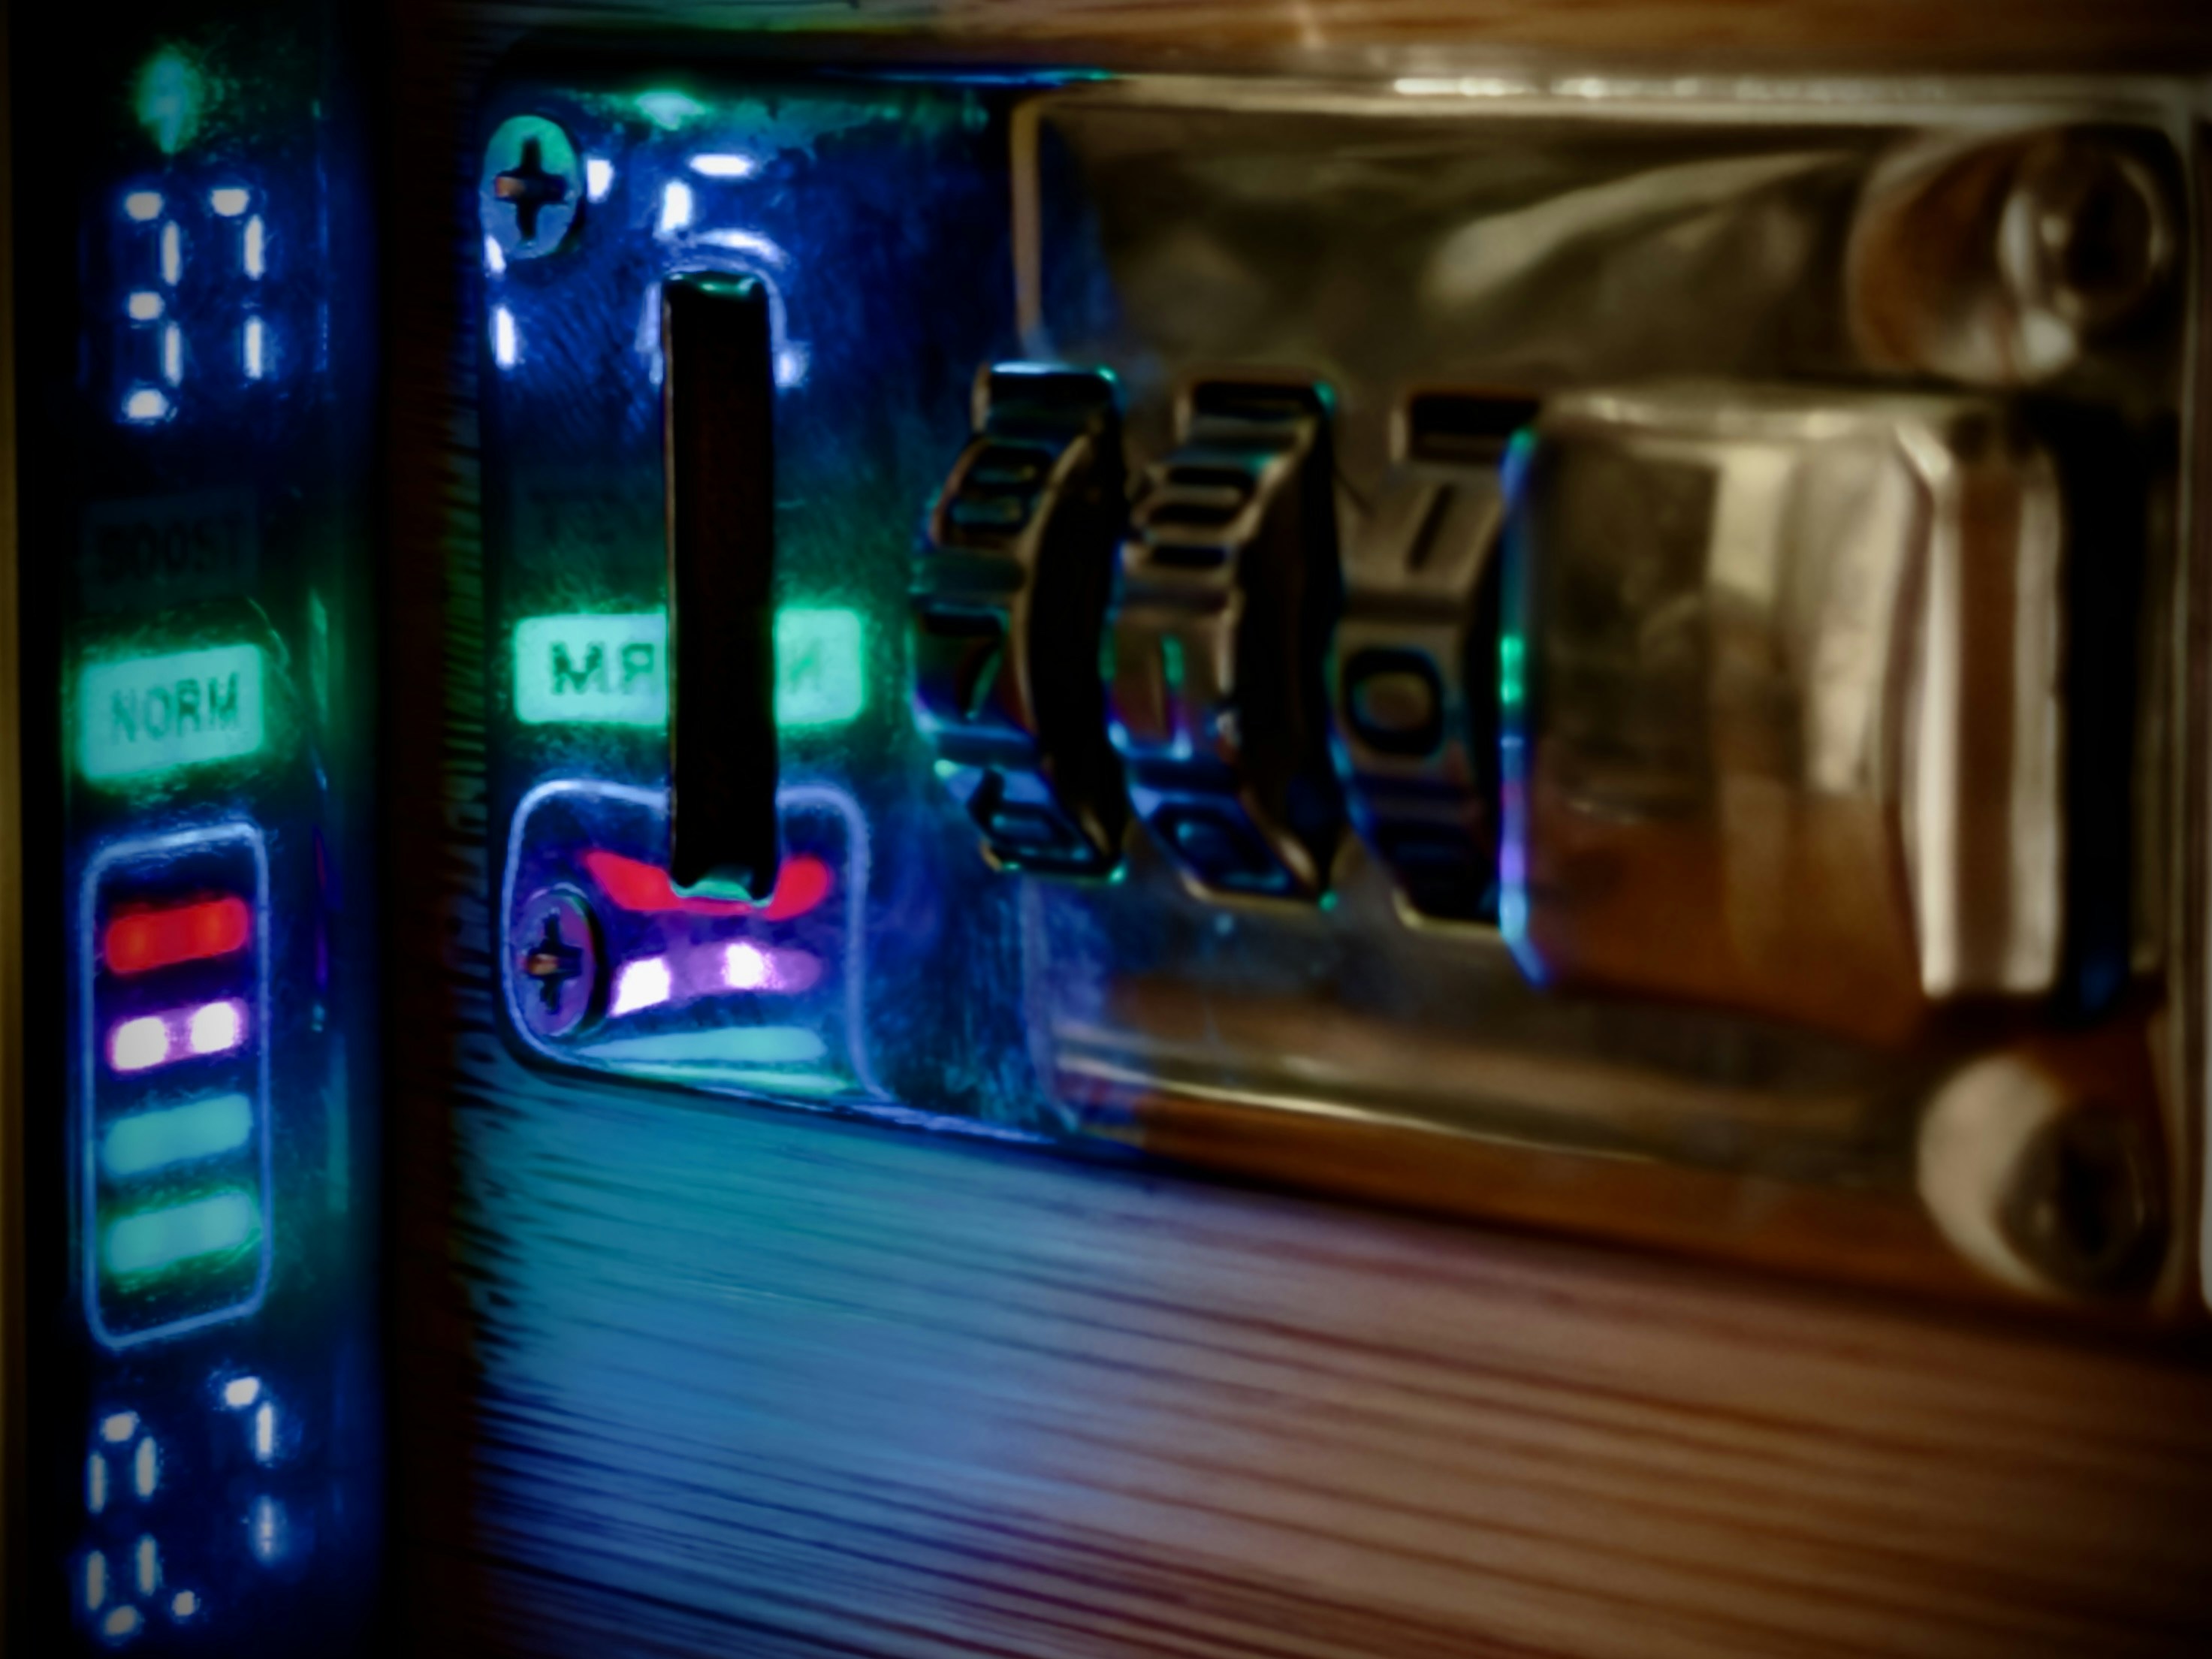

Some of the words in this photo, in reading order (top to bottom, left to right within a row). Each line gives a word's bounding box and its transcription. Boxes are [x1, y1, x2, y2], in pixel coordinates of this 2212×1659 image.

[123, 186, 266, 420] 37
[98, 512, 242, 581] BOOST
[111, 672, 240, 744] NORM
[919, 605, 1008, 721] 7
[1344, 648, 1443, 755] 0
